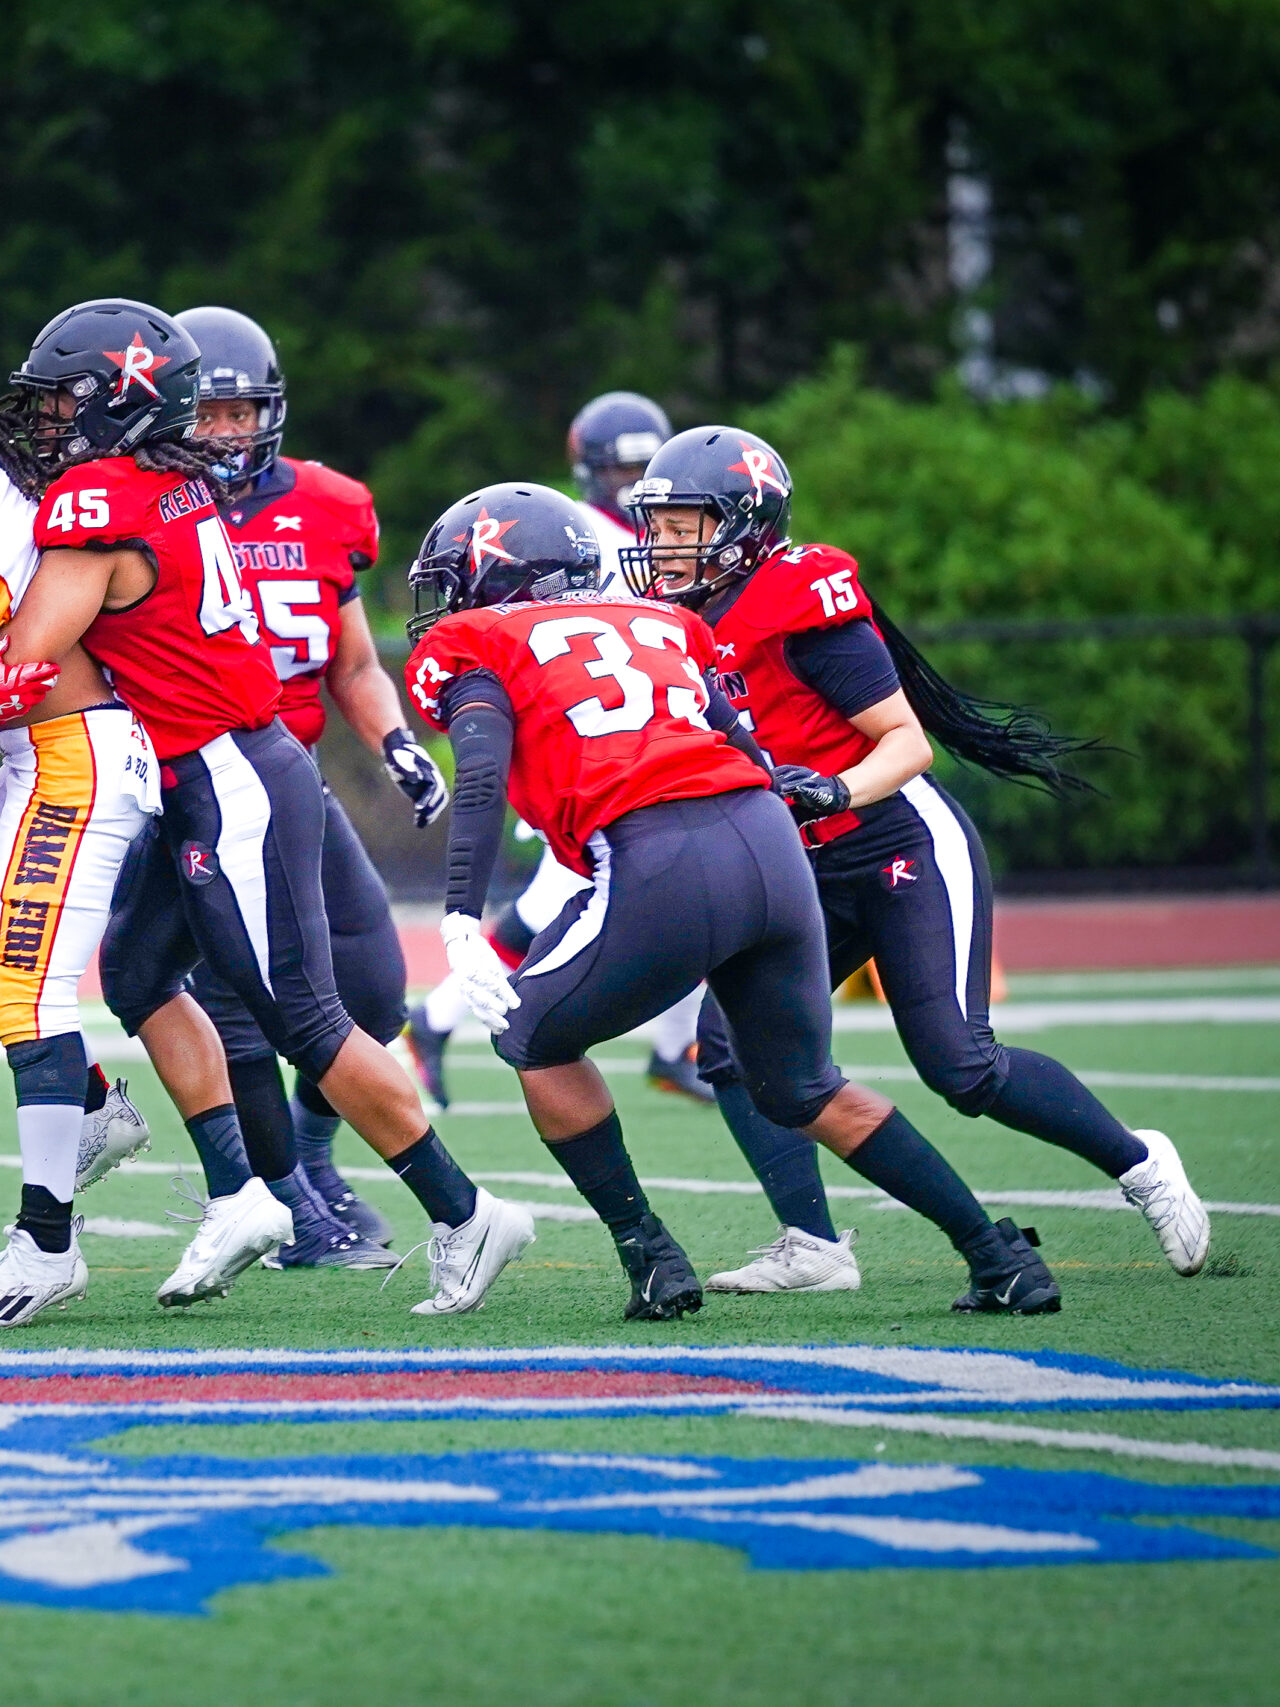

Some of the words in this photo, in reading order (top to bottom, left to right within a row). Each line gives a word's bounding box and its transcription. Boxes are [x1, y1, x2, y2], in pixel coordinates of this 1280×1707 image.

[109, 345, 161, 407] R
[742, 450, 789, 506] R
[47, 489, 110, 532] 45
[471, 518, 520, 568] R
[196, 513, 260, 647] 4
[810, 569, 858, 618] 15
[527, 616, 711, 738] 33
[14, 801, 79, 885] BAMA
[190, 851, 214, 877] R
[892, 860, 918, 887] R
[0, 898, 49, 972] FIRE
